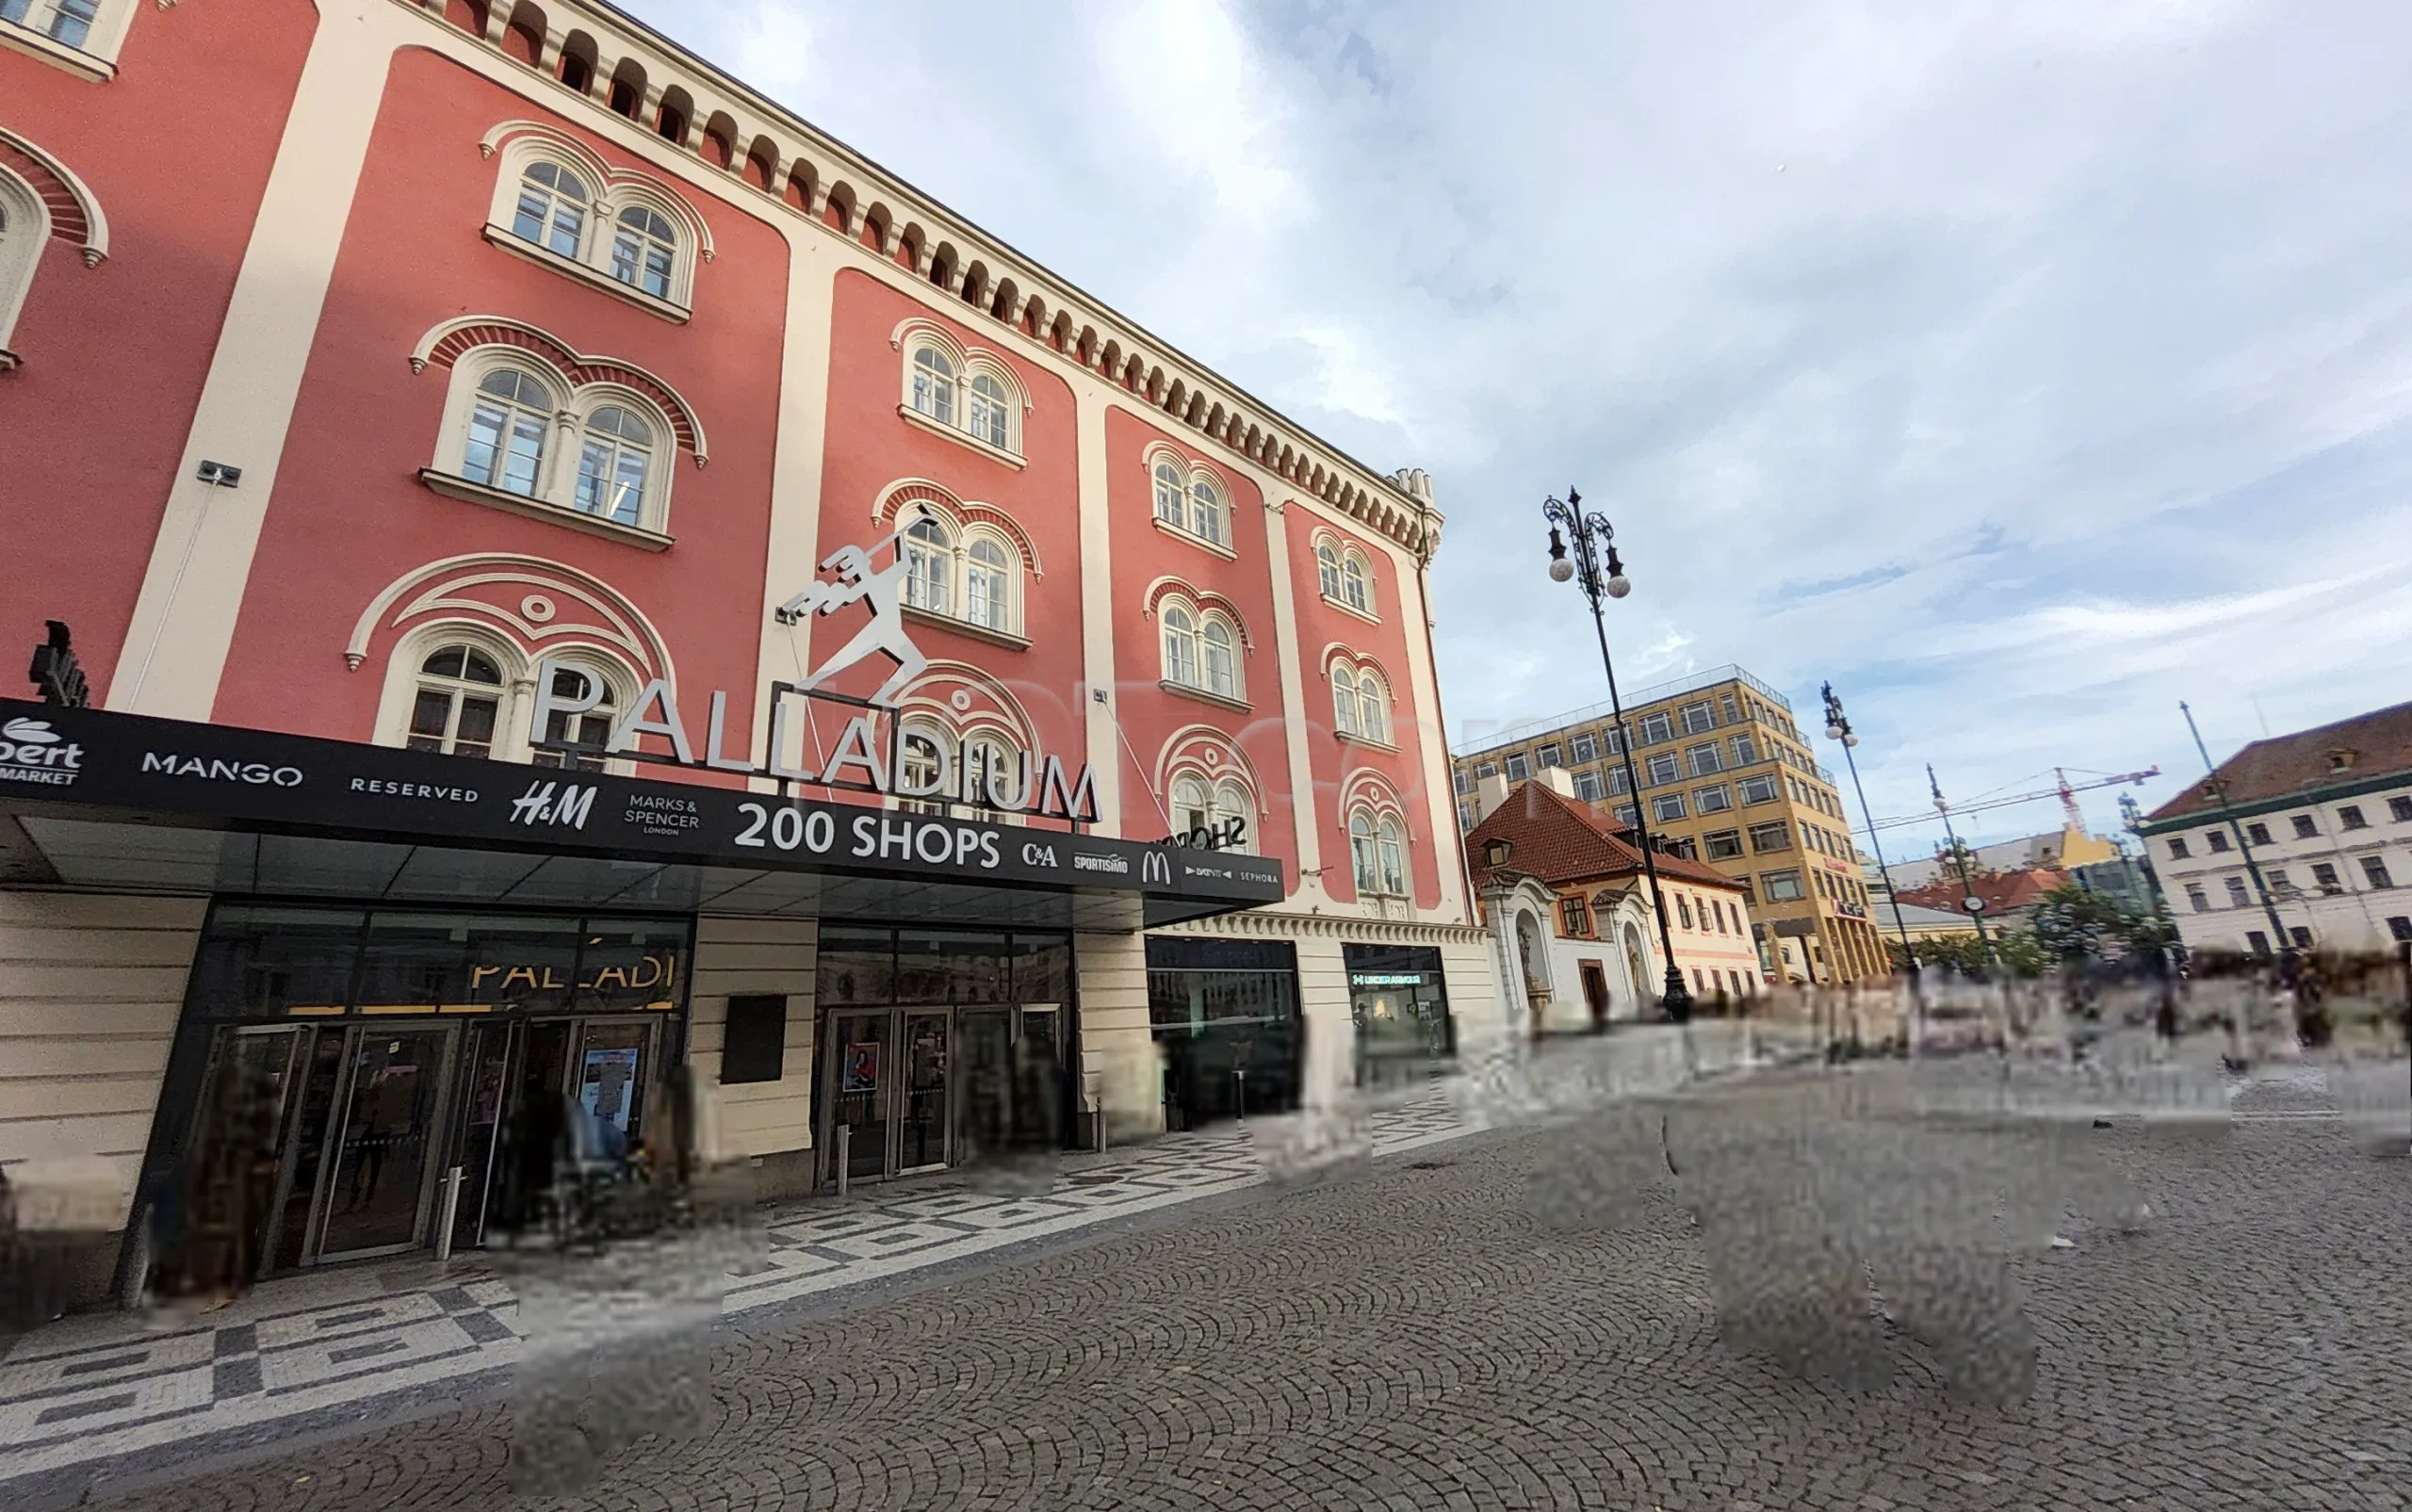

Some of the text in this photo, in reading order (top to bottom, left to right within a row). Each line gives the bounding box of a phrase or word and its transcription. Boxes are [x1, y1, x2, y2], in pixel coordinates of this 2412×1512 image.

[529, 658, 1103, 822] PALLADIUM
[141, 752, 302, 788] MANGO
[350, 777, 479, 803] RESERVED
[510, 779, 597, 829] H&M
[629, 794, 697, 813] MARKS &
[624, 809, 699, 828] SPENCER
[644, 826, 679, 836] LONDON
[734, 802, 1001, 870] 200 SHOPS
[1021, 843, 1058, 869] C&A
[1074, 854, 1129, 874] SPORTISIMO
[1240, 871, 1279, 884] SEPHORA
[1364, 975, 1391, 984] UNDER
